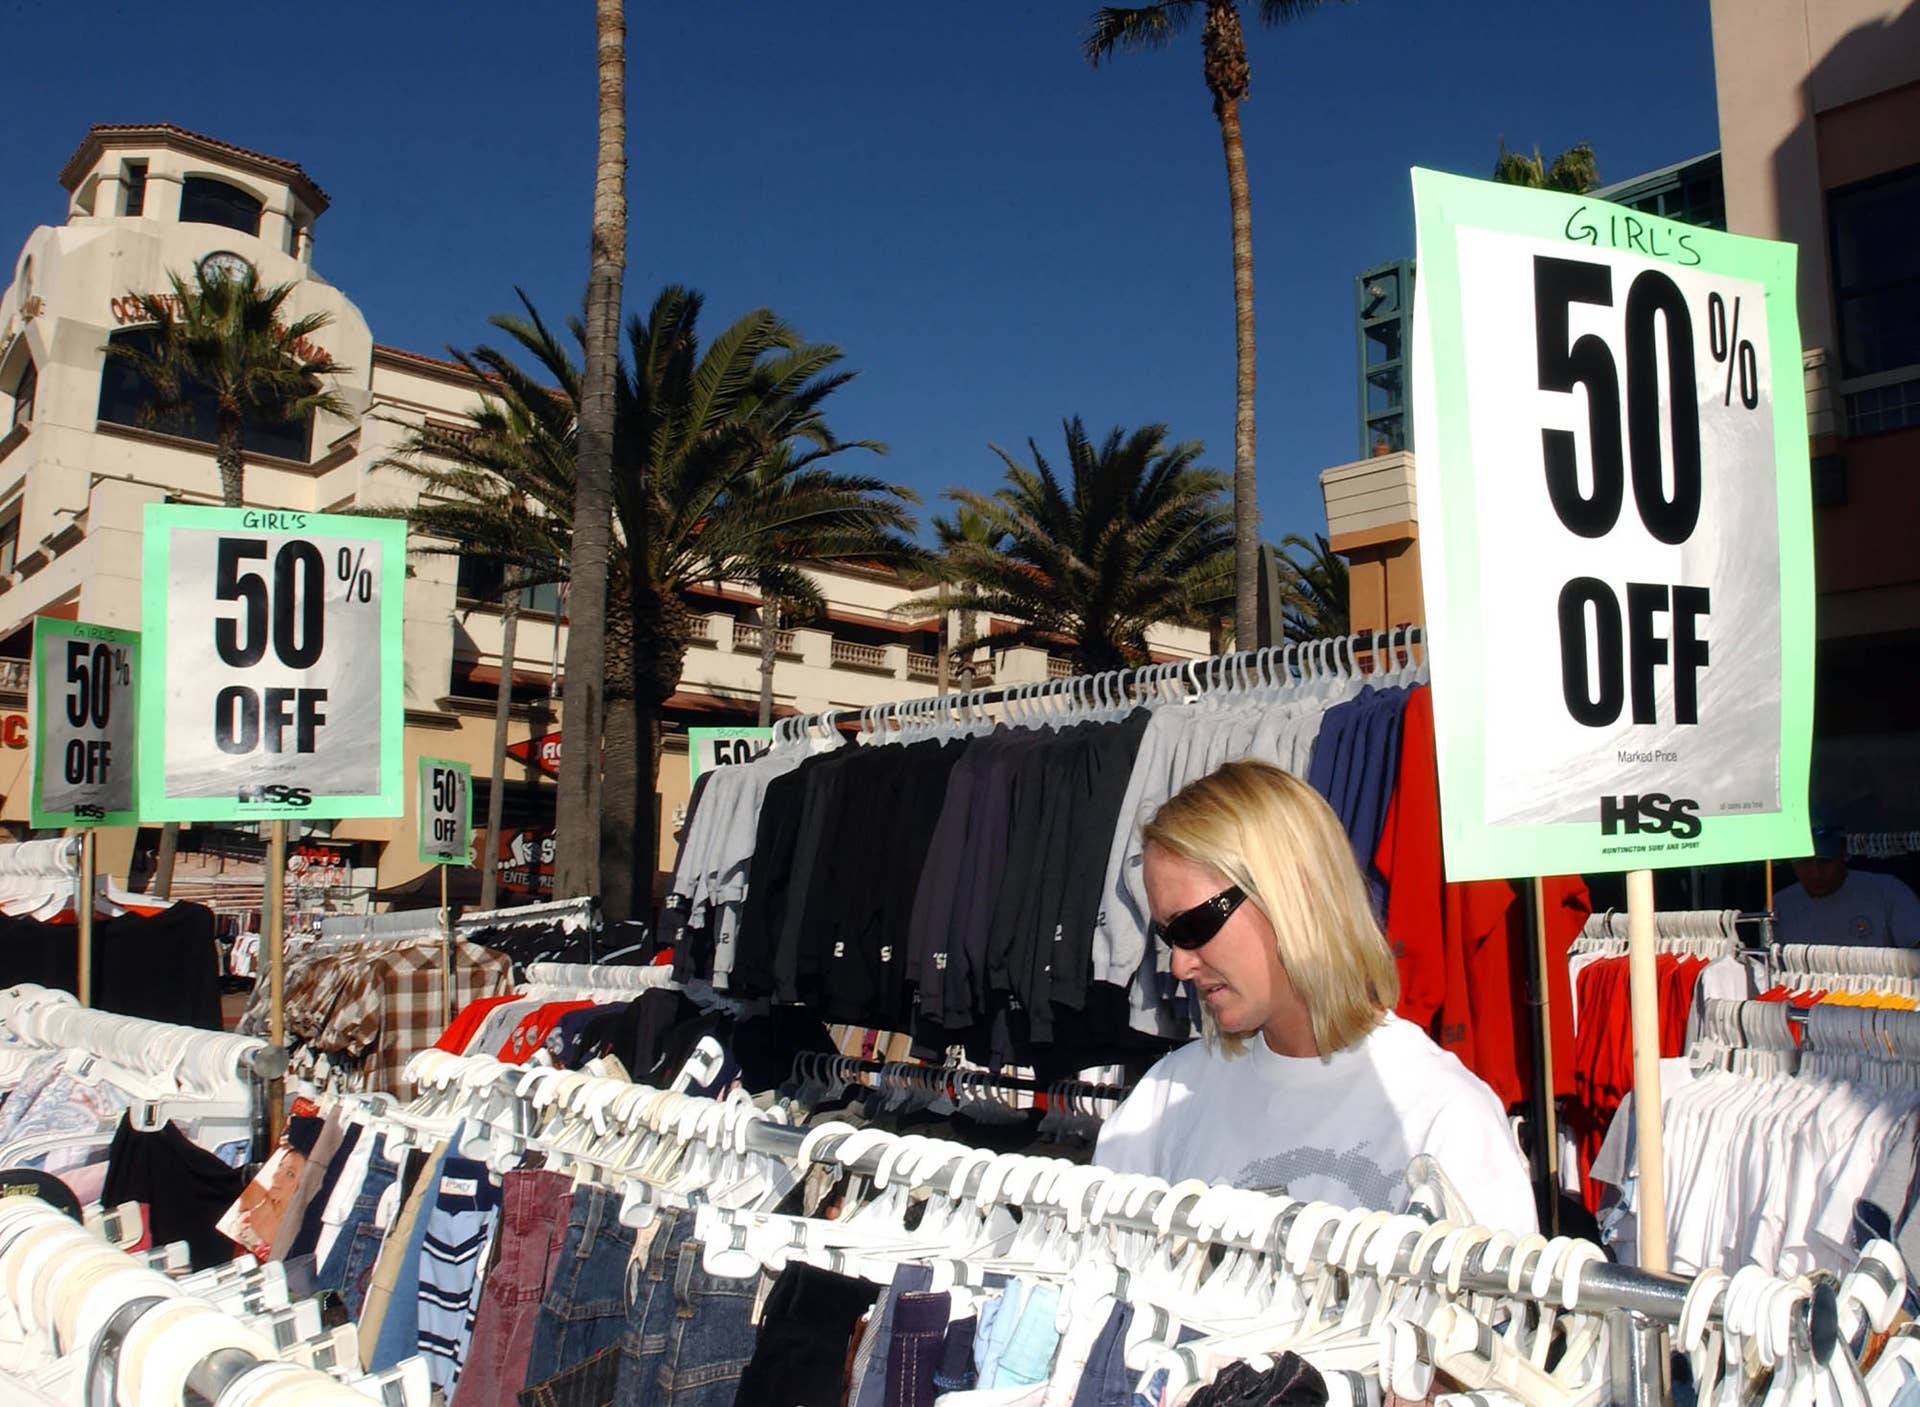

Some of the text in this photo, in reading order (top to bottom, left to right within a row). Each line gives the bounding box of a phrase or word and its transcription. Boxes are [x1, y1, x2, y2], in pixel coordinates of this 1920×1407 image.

[1564, 206, 1701, 266] GIRL'S
[243, 511, 307, 530] GIRL'S
[1558, 576, 1710, 728] OFF
[215, 686, 328, 754] OFF
[65, 739, 112, 785] OFF
[434, 818, 456, 842] OFF
[1601, 792, 1703, 839] HSS
